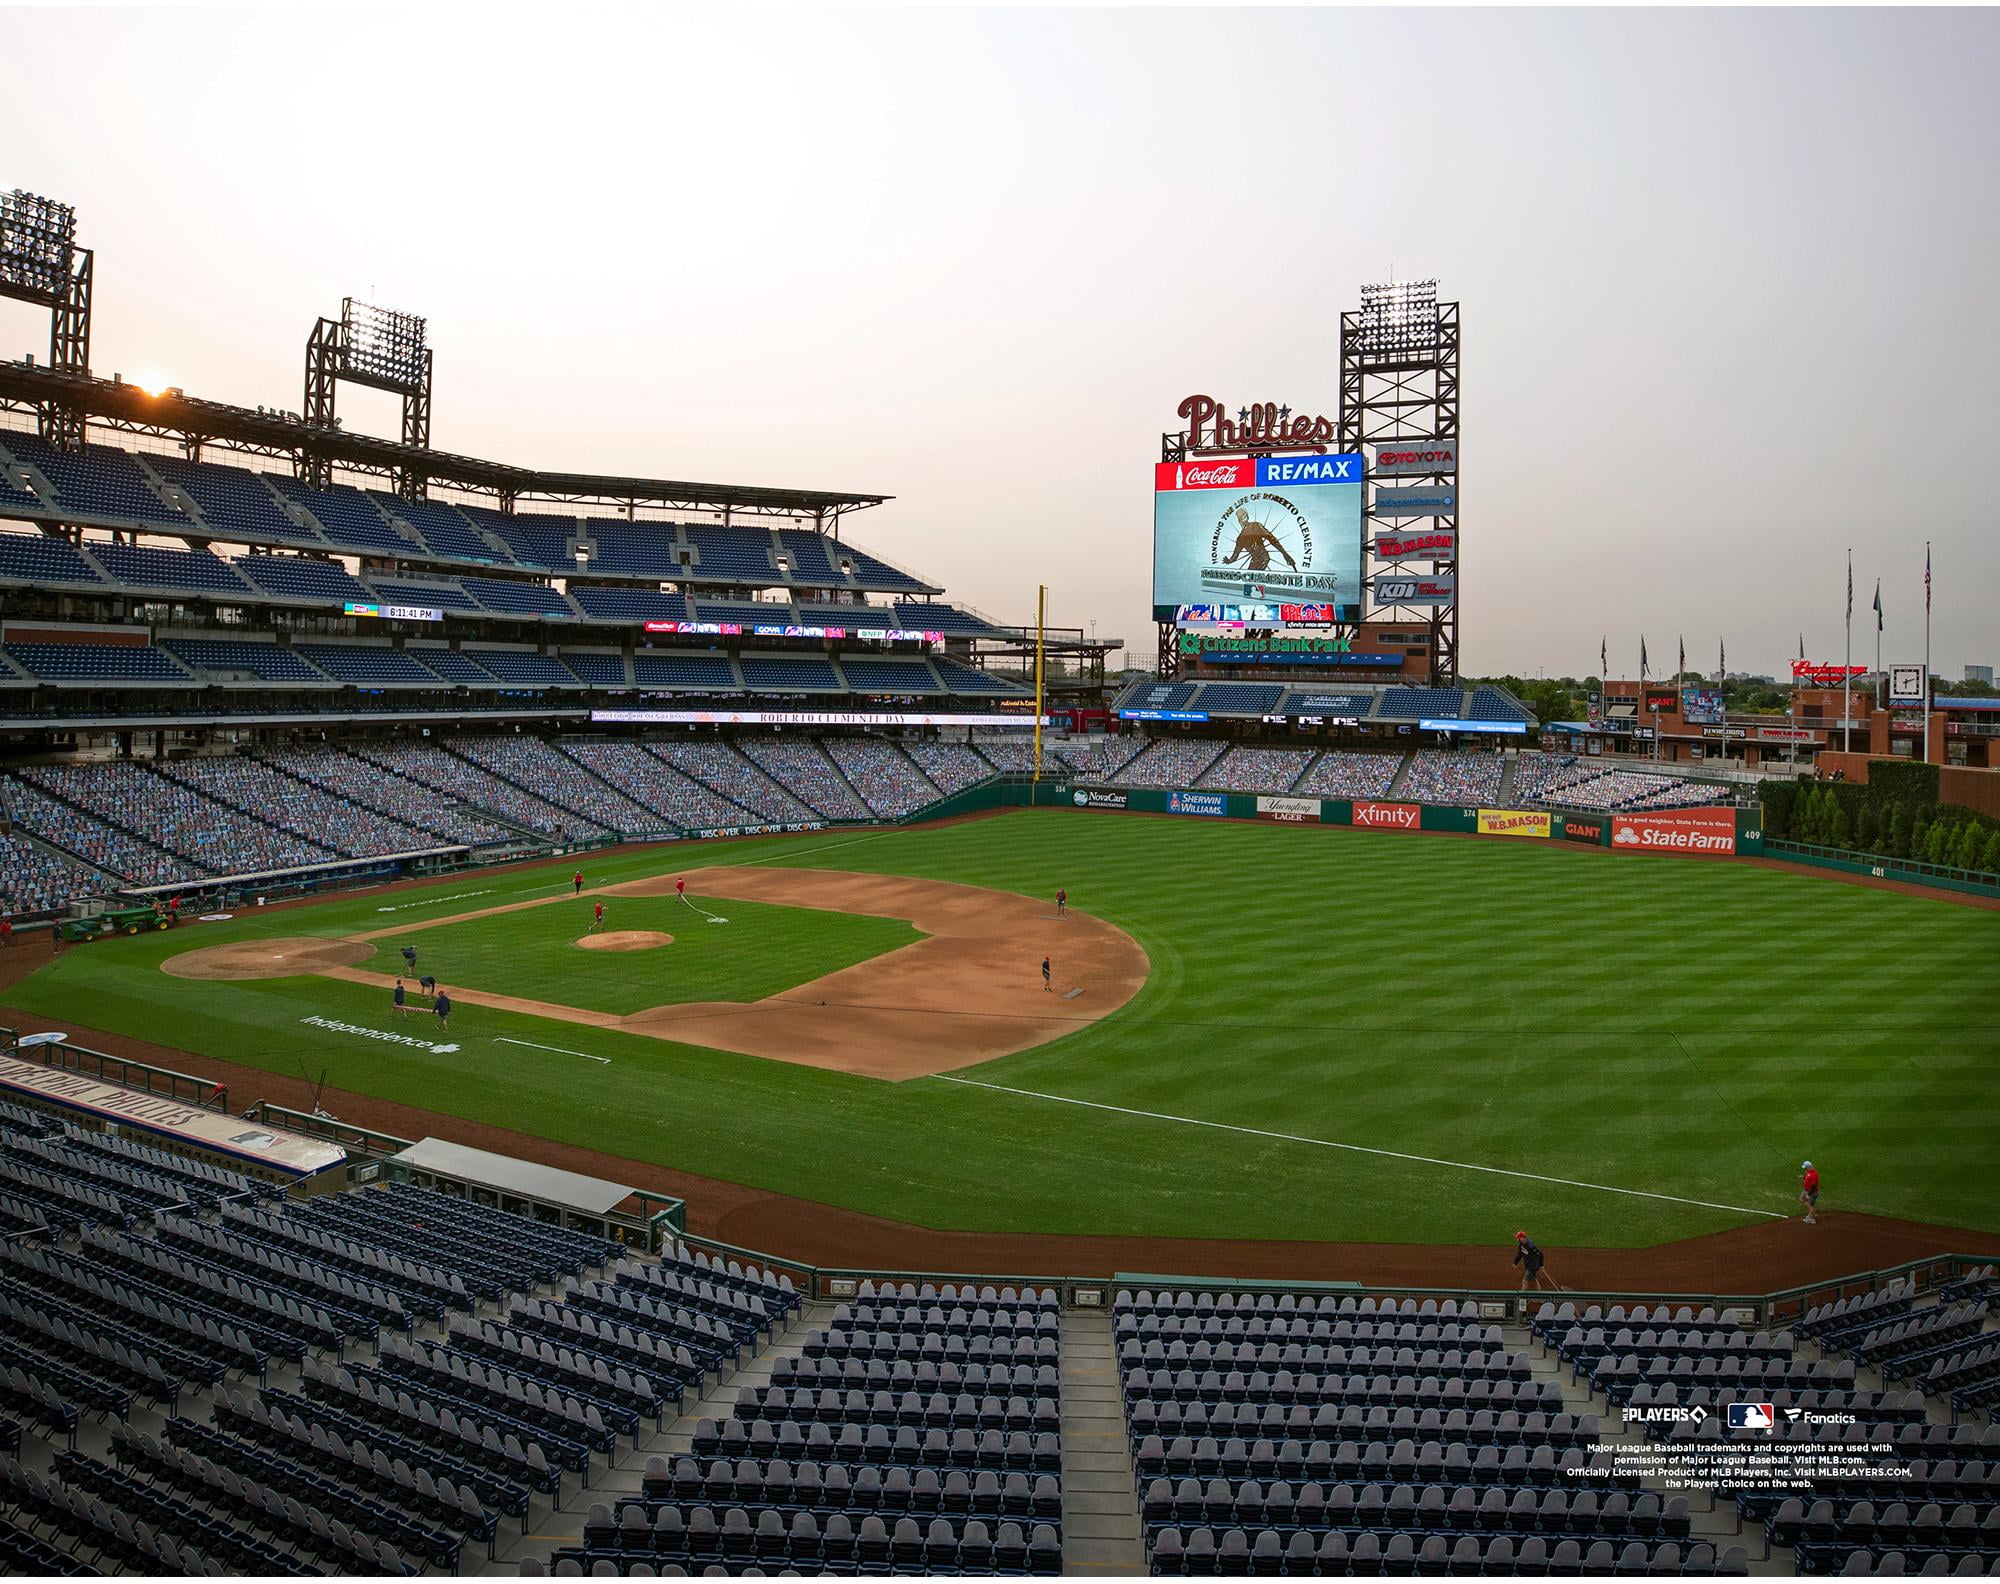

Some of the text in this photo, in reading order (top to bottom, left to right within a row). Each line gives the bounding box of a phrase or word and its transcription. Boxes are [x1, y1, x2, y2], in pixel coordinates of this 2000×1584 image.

[1177, 394, 1334, 448] Phillies
[1397, 450, 1453, 463] TOYOTA
[1185, 464, 1240, 486] Coca-Cola
[1267, 460, 1352, 481] RE/MAX
[1211, 492, 1313, 569] HONORING THE LIFE OF ROBERTO CLEMENTE
[1241, 571, 1303, 587] CLEMENTE
[1305, 575, 1338, 590] DAY
[1377, 583, 1417, 598] KDI
[390, 608, 432, 618] 6:11:41 PM
[758, 626, 780, 634] GOYA
[1203, 637, 1351, 653] Citizens Bank Park
[1647, 697, 1675, 706] GIANT
[884, 715, 906, 724] DAY
[1088, 791, 1127, 803] NovaCare
[1181, 793, 1221, 805] SHERWIN
[1265, 798, 1313, 812] Yuengling
[1357, 804, 1417, 828] xfinity
[701, 827, 739, 838] DISCOVER
[745, 825, 781, 835] DISCOVER
[1565, 823, 1601, 838] GIANT
[1744, 830, 1760, 840] 409
[1872, 866, 1884, 877] 401
[300, 1015, 434, 1048] Independence
[88, 1090, 206, 1126] PHILLIES
